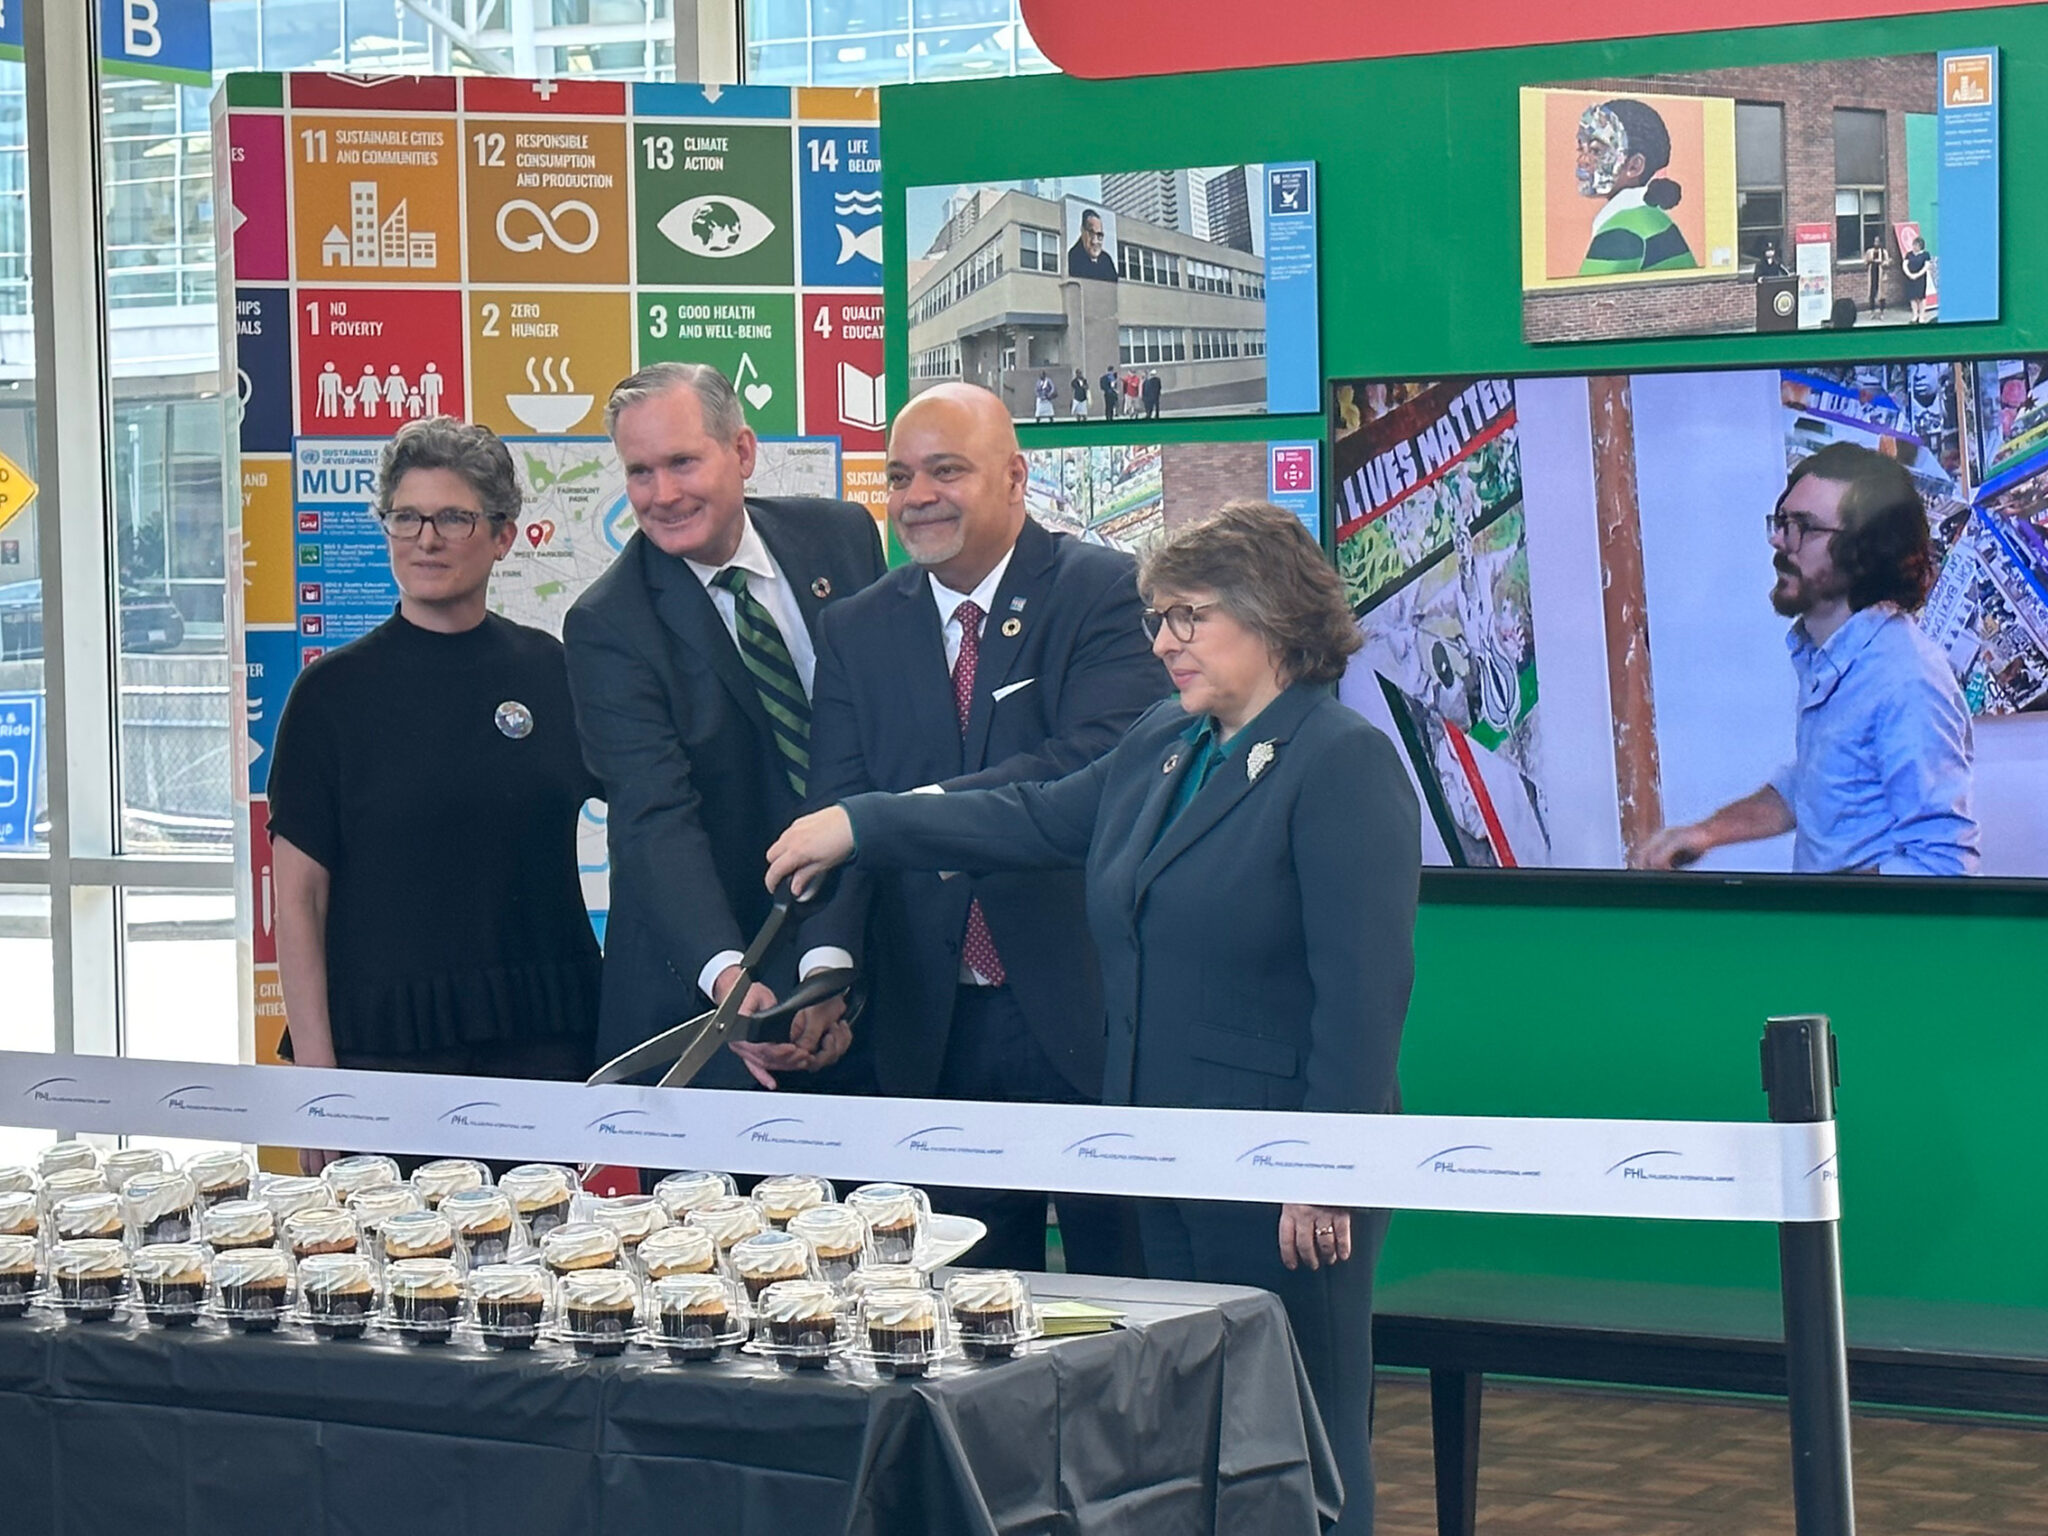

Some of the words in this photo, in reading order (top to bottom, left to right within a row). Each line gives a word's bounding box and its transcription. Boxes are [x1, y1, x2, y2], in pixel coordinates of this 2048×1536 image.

[123, 0, 162, 57] B
[336, 130, 408, 145] SUSTAINABLE
[410, 132, 444, 146] CITIES
[516, 134, 588, 149] RESPONSIBLE
[684, 137, 729, 152] CLIMATE
[301, 129, 328, 163] 11
[473, 133, 506, 167] 12
[643, 136, 674, 170] 13
[848, 140, 869, 154] LIFE
[336, 150, 360, 164] AND
[362, 150, 438, 166] COMMUNITIES
[516, 153, 596, 169] CONSUMPTION
[684, 156, 724, 171] ACTION
[807, 139, 839, 173] 14
[517, 173, 540, 187] AND
[543, 173, 613, 188] PRODUCTION
[330, 301, 347, 316] NO
[511, 303, 540, 318] ZERO
[678, 305, 710, 319] GOOD
[713, 305, 755, 319] HEALTH
[305, 301, 320, 336] 1
[482, 303, 500, 337] 2
[649, 304, 668, 338] 3
[813, 306, 833, 339] 4
[330, 321, 383, 336] POVERTY
[511, 323, 559, 337] HUNGER
[678, 324, 702, 338] AND
[705, 324, 772, 339] WELL-BEING
[1342, 438, 1418, 521] LIVES
[1416, 379, 1512, 473] MATTER
[243, 472, 267, 487] AND
[847, 490, 868, 504] AND
[751, 1132, 770, 1142] PHL
[909, 1141, 929, 1151] PHL
[1252, 1155, 1274, 1166] PHL
[1434, 1162, 1456, 1173] PHL
[1624, 1168, 1648, 1179] PHL
